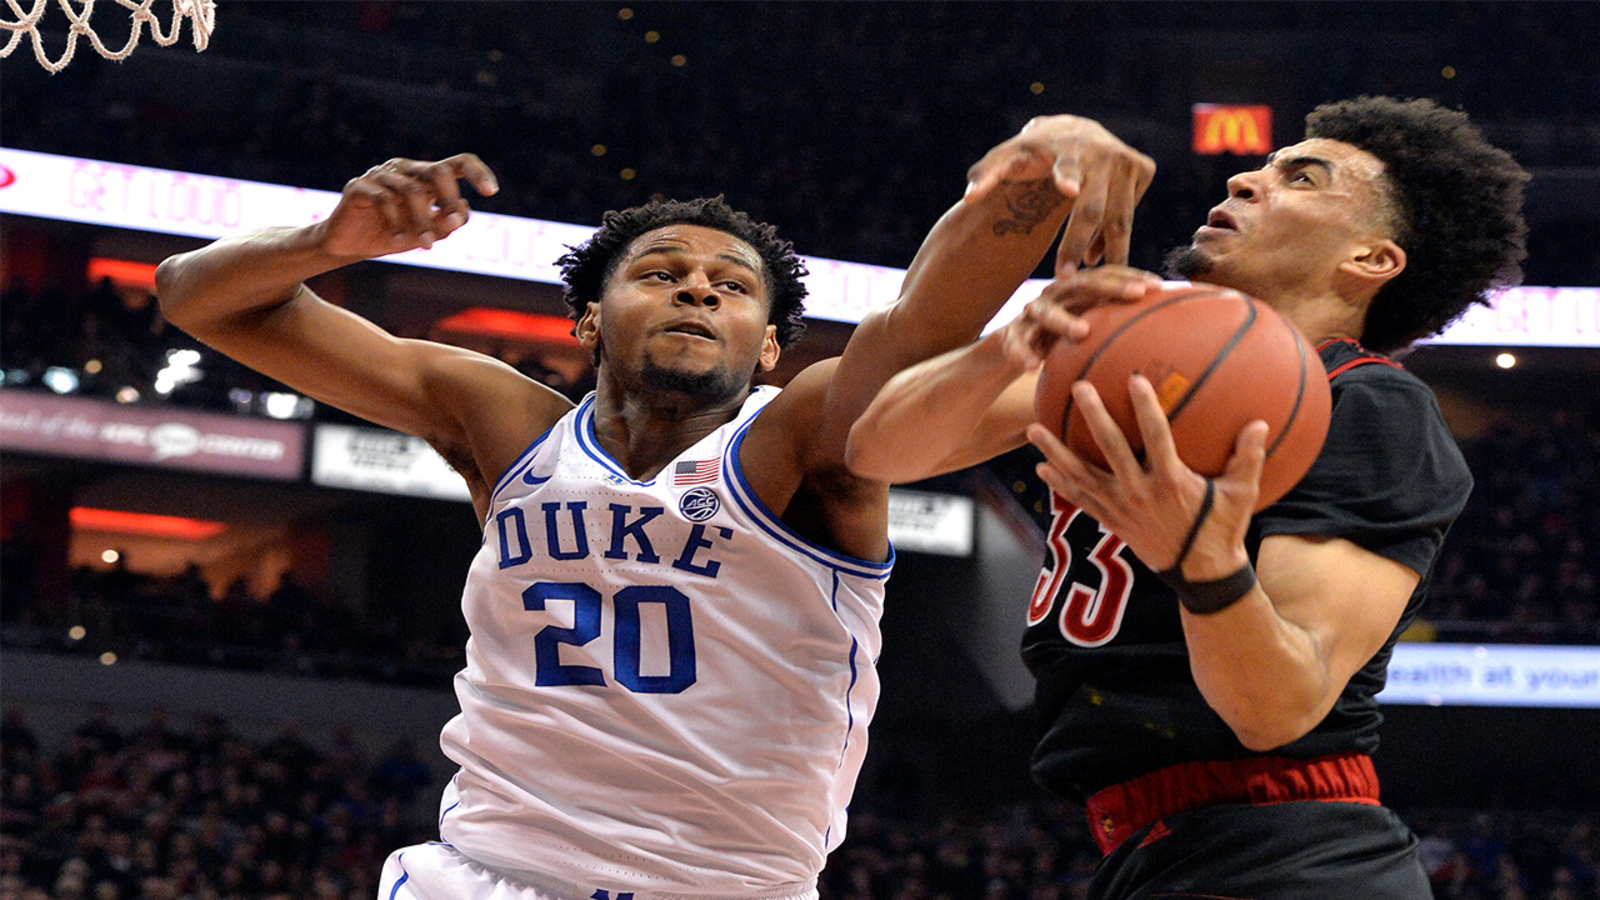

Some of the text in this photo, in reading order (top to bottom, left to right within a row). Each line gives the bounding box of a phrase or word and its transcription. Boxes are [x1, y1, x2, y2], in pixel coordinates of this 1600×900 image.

[498, 501, 734, 579] DUKE
[1026, 490, 1135, 648] 33
[522, 582, 698, 694] 20
